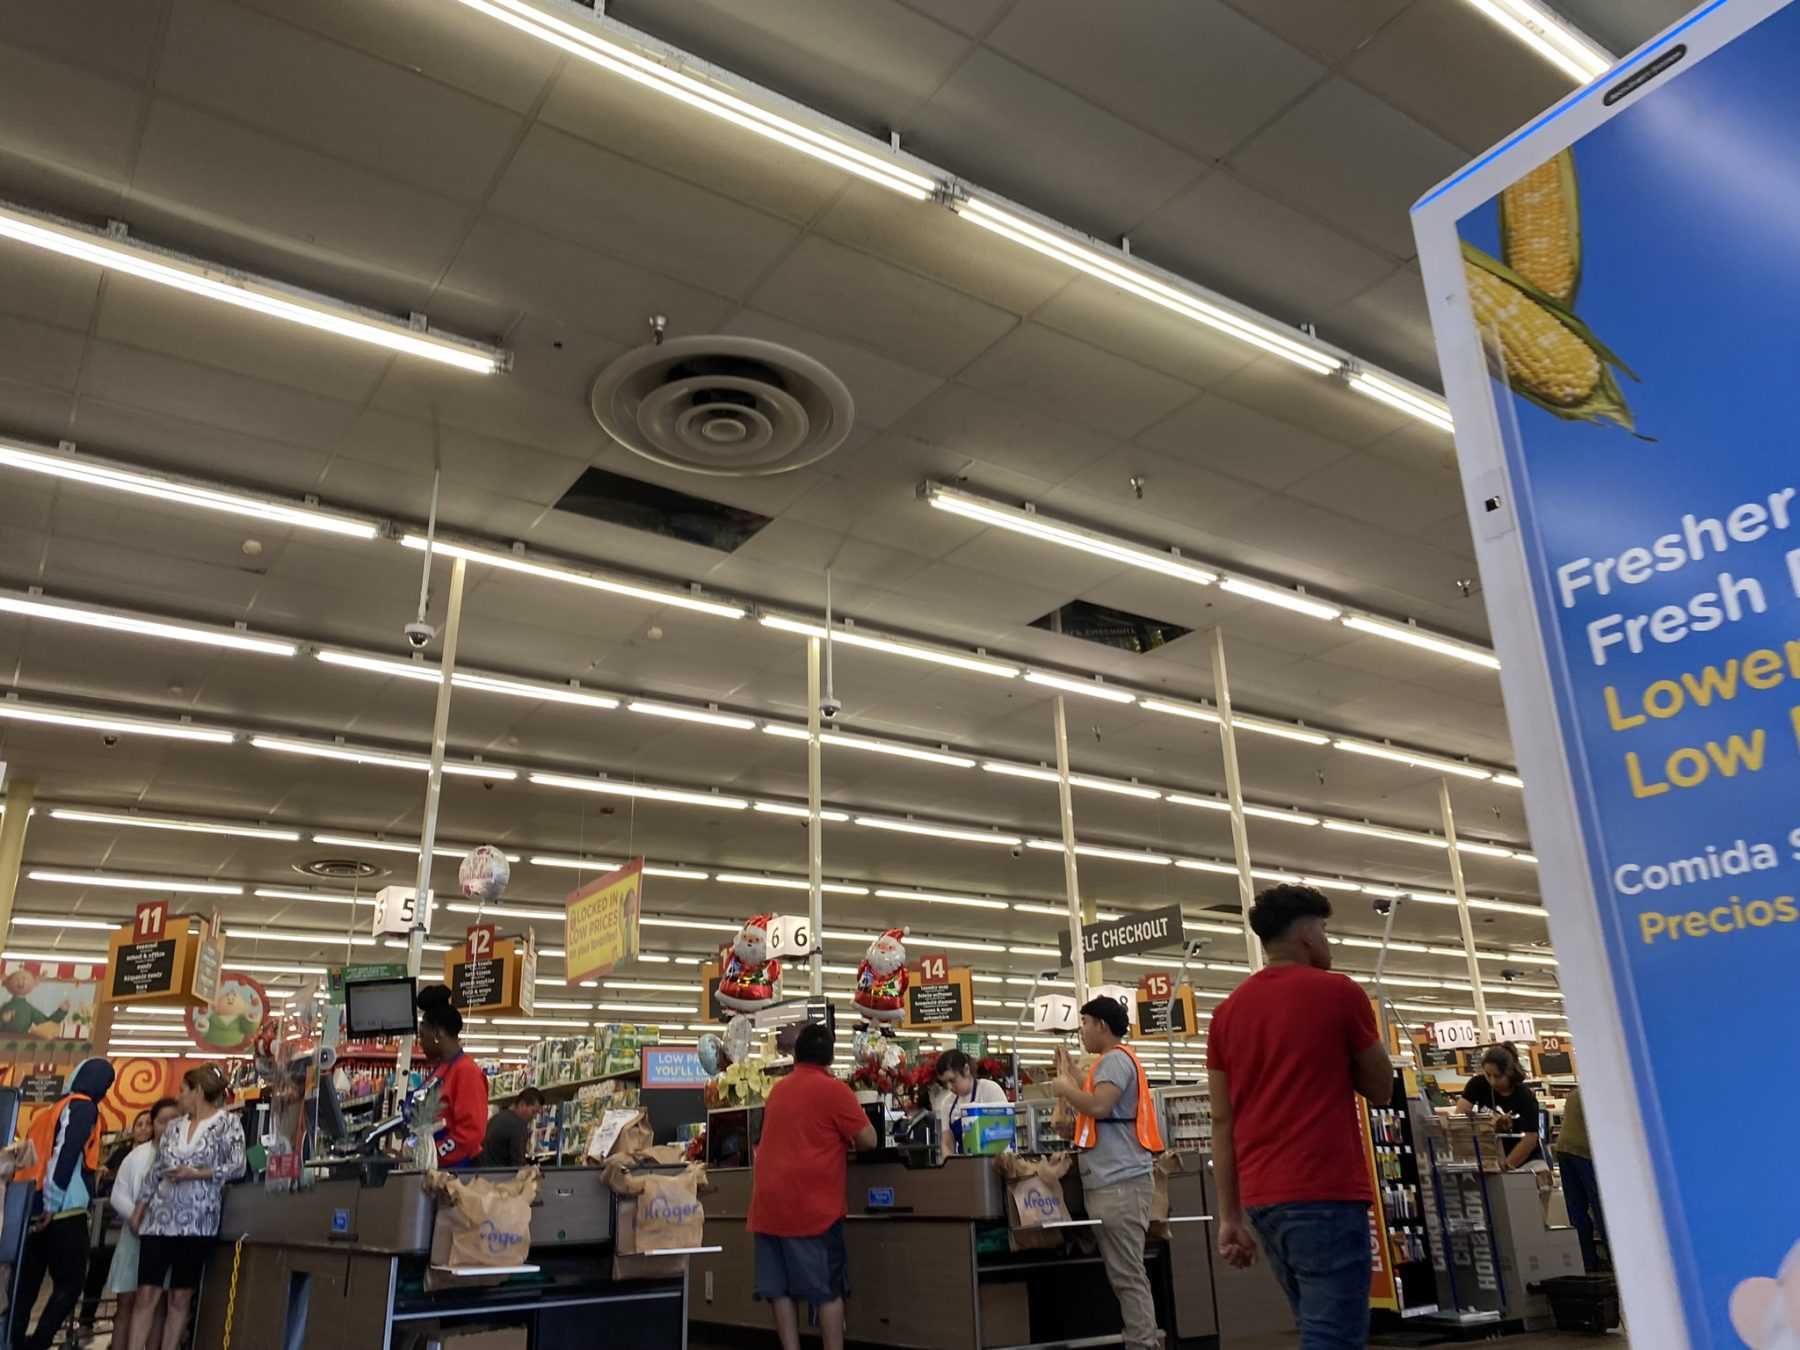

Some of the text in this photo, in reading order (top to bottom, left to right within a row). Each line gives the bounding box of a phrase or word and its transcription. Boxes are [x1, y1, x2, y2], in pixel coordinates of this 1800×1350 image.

[1557, 488, 1796, 608] Fresher
[1587, 572, 1767, 666] Fresh
[1625, 729, 1766, 798] Low
[1614, 840, 1778, 895] Comida
[400, 898, 415, 922] 5
[576, 891, 619, 924] LOCKED IN
[1638, 895, 1799, 944] Precios
[139, 906, 162, 935] 11
[569, 911, 618, 945] LOW PRICES
[468, 930, 490, 955] 12
[772, 927, 780, 949] 6
[794, 926, 808, 947] 6
[1102, 918, 1168, 948] CHECKOUT
[921, 958, 946, 979] 14
[1147, 976, 1169, 995] 15
[1041, 1004, 1048, 1022] 7
[1062, 1004, 1072, 1022] 7
[1543, 1038, 1559, 1050] 20
[655, 1065, 693, 1075] YOU'LL
[658, 1053, 683, 1064] LOW
